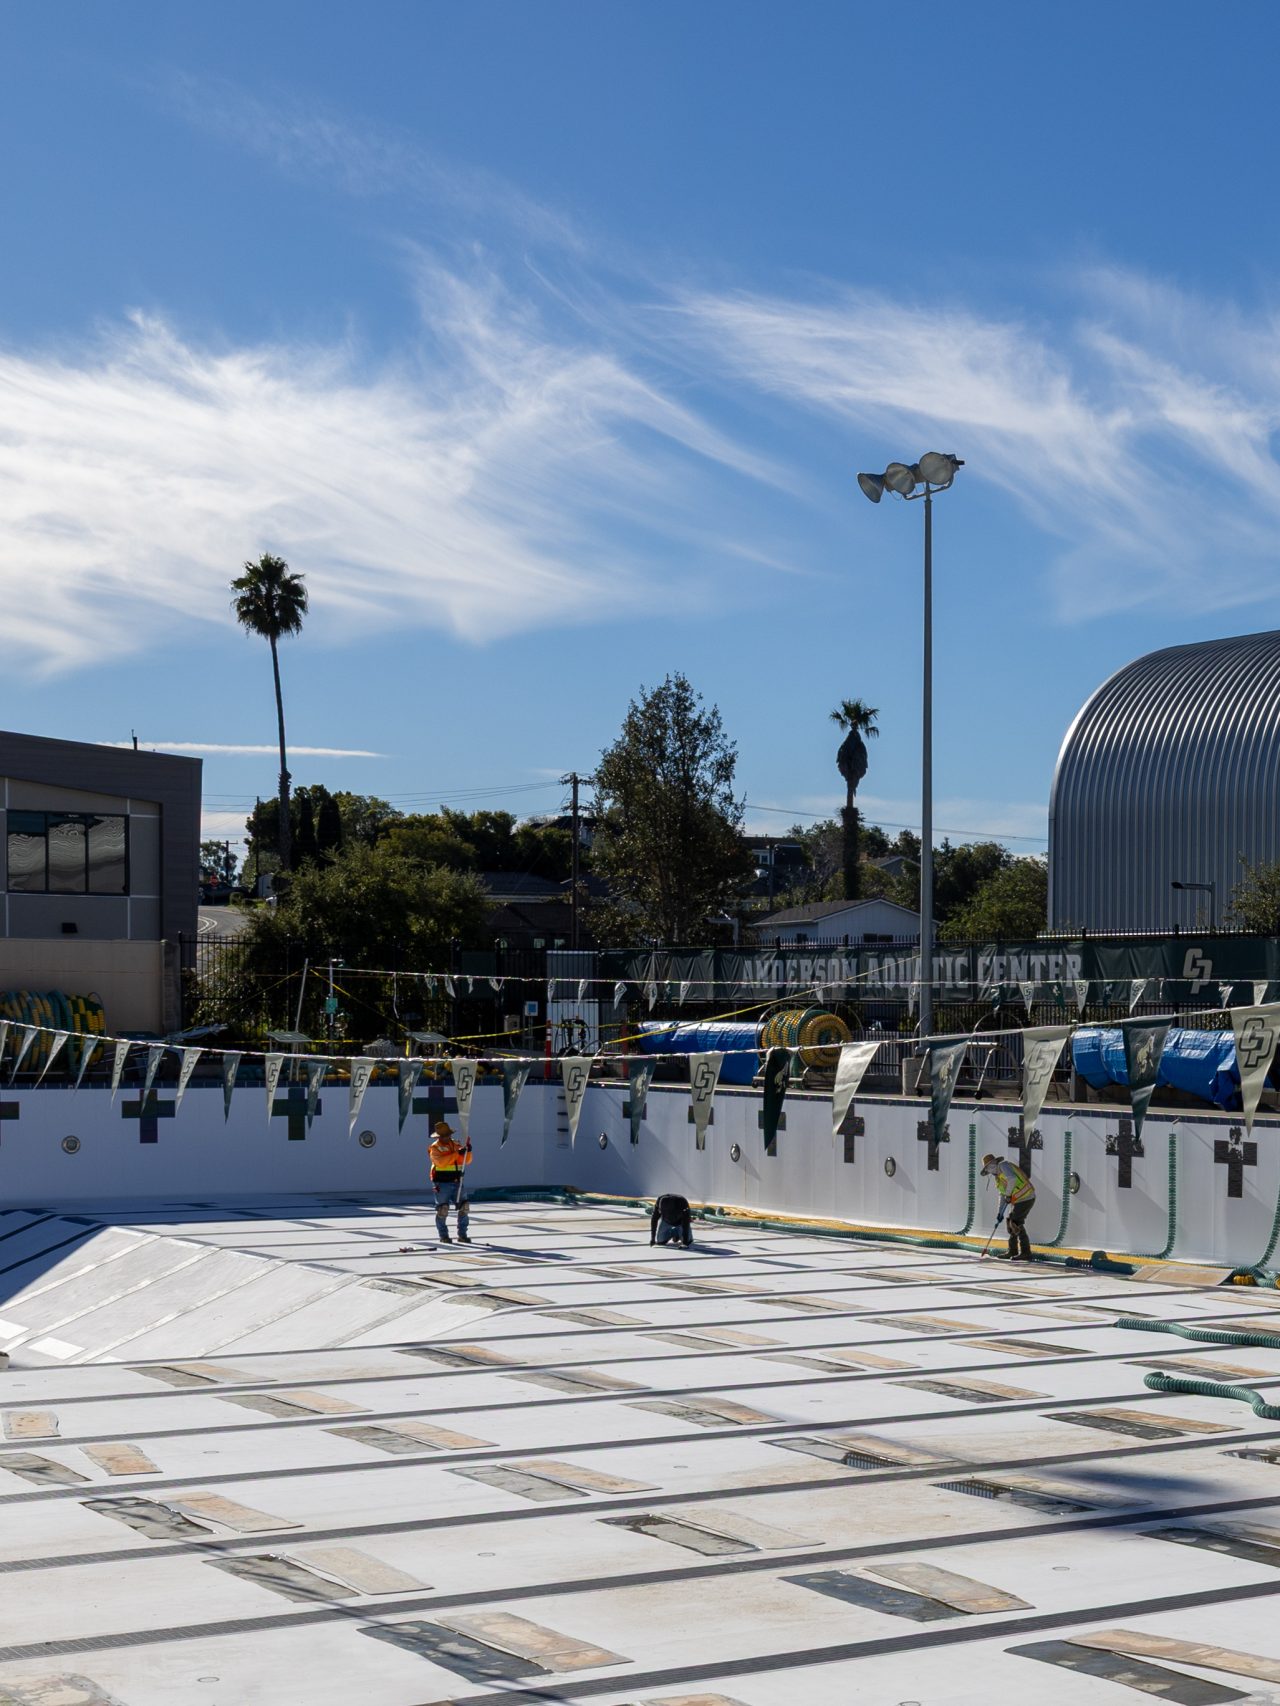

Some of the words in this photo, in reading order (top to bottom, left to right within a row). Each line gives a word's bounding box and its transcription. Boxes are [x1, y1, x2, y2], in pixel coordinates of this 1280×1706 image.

[742, 957, 858, 989] ANDERSON
[977, 954, 1082, 988] CENTER
[1182, 948, 1213, 994] CP
[1238, 1017, 1274, 1068] CP
[694, 1062, 716, 1101] CP
